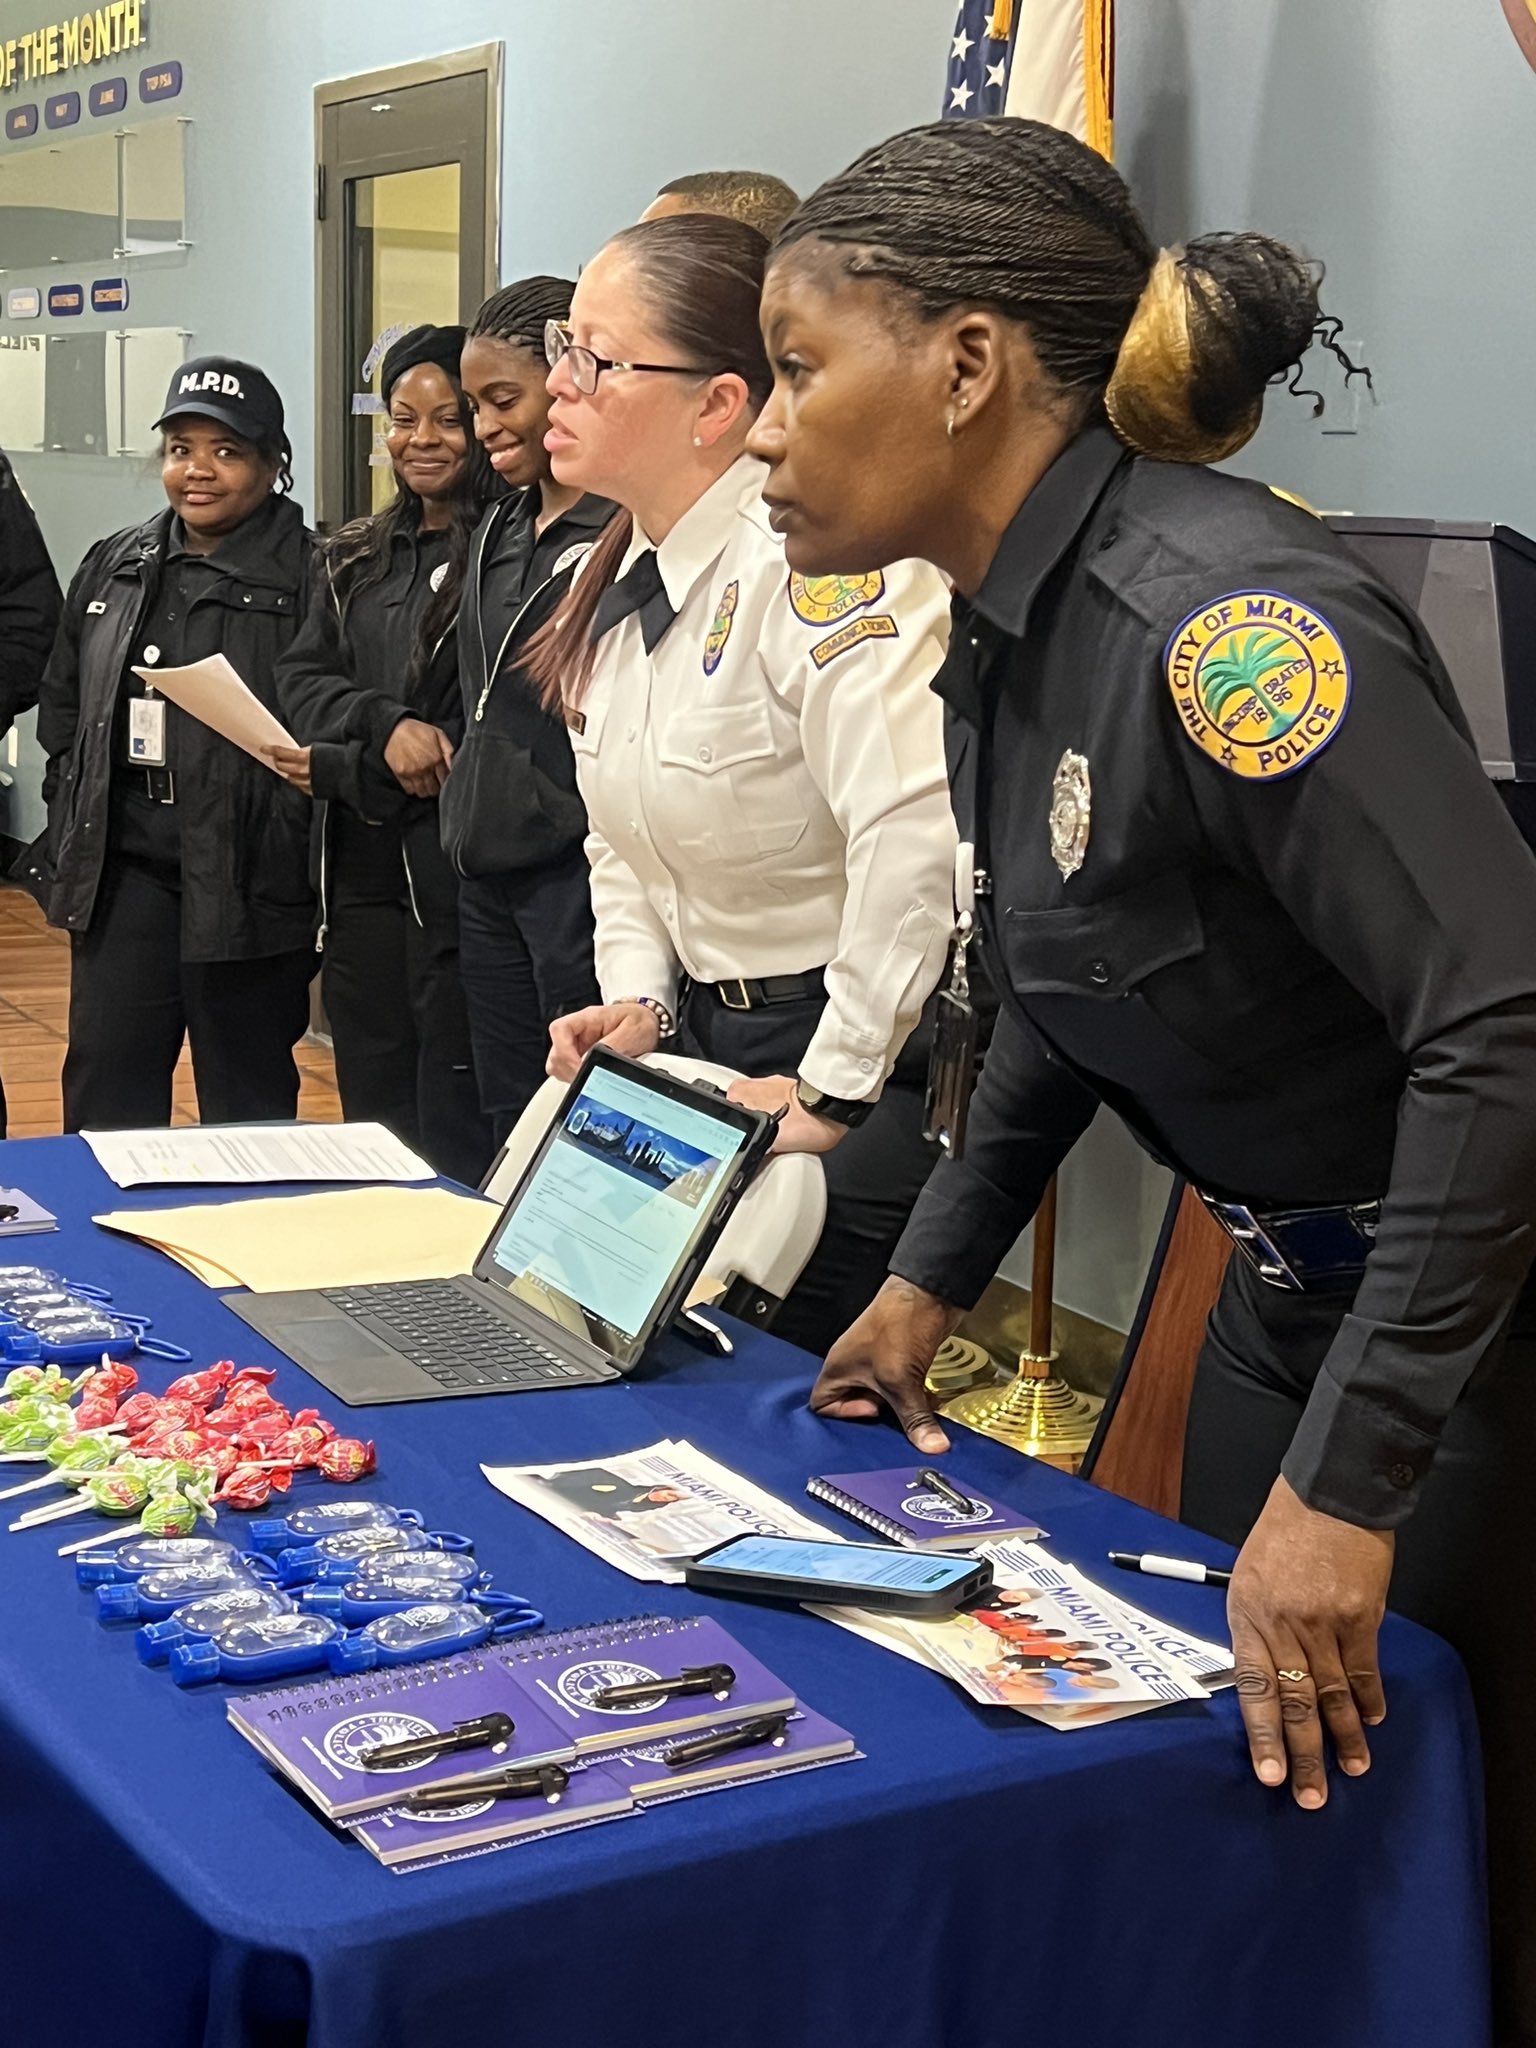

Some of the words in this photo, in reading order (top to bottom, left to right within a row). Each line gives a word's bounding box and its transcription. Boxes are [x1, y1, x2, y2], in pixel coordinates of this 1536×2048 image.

[19, 25, 59, 81] THE
[63, 0, 140, 69] MONTH
[179, 371, 244, 399] M.P.D.
[1203, 605, 1232, 632] OF
[1245, 599, 1326, 642] MIAMI
[1173, 628, 1202, 689] CITY
[1179, 696, 1207, 742] THE
[1258, 703, 1336, 772] POLICE
[1045, 1586, 1112, 1629] MIAMI
[1092, 1631, 1173, 1682] POLICE
